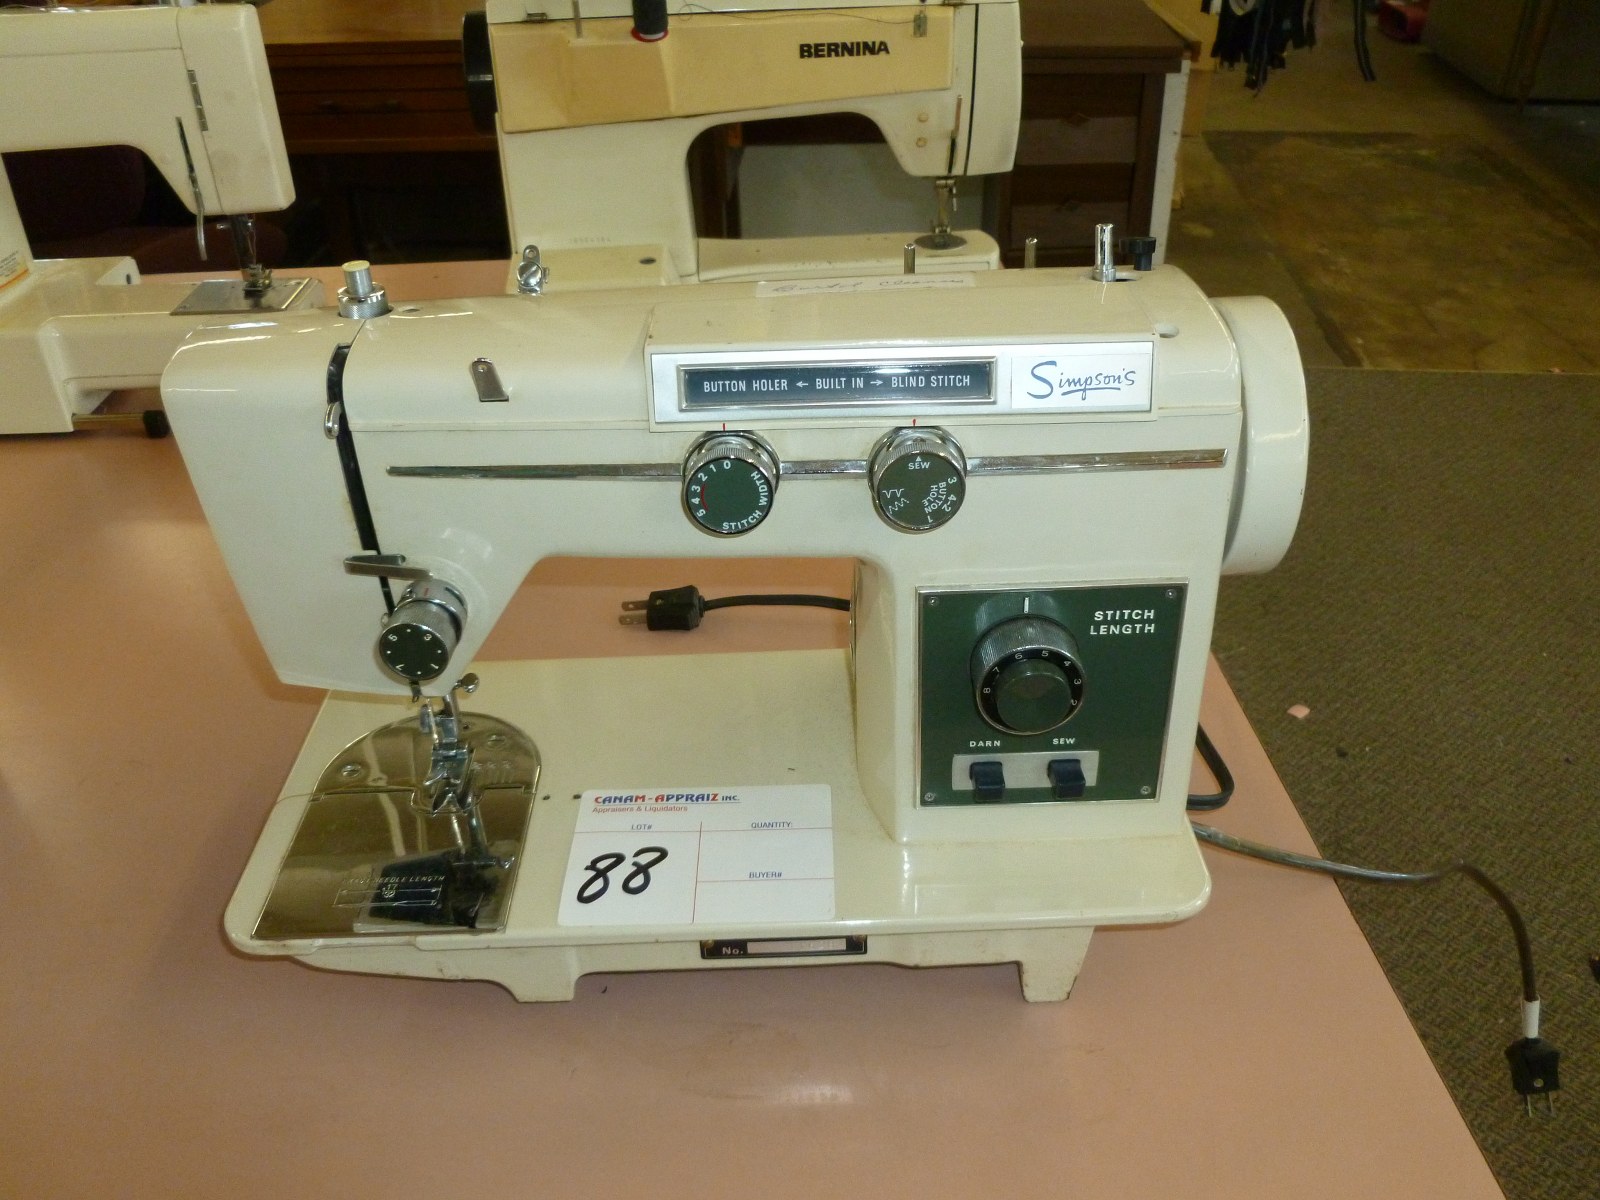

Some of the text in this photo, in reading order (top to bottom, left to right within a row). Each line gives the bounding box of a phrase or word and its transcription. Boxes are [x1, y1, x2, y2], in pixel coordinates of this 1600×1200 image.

[798, 40, 891, 59] BERNINA
[703, 373, 971, 393] BUTTON HOLER BUILT IN BLIND STITCH
[1027, 360, 1136, 401] Simpson's
[709, 463, 717, 473] 1
[723, 460, 731, 470] 0
[908, 461, 931, 470] SEW
[698, 472, 708, 482] 2
[947, 475, 958, 485] 3
[691, 484, 701, 493] 3
[691, 496, 701, 505] 4
[922, 484, 939, 507] HOLE
[925, 481, 947, 514] BUTTON
[722, 471, 769, 531] STITCH WIDTH
[696, 508, 706, 518] 5
[1093, 609, 1155, 621] STITCH
[1089, 623, 1156, 635] LENGTH
[388, 633, 398, 642] 5
[423, 633, 433, 641] 3
[395, 663, 405, 671] 7
[969, 739, 1001, 748] DARN
[1052, 737, 1076, 745] SEW
[592, 806, 634, 814] Appraisers
[644, 804, 688, 814] Liquidators
[631, 823, 652, 831] LOT#
[751, 821, 793, 829] QUANTITY:
[576, 845, 669, 904] 88
[748, 871, 783, 879] BUYER#
[722, 945, 744, 956] No.
